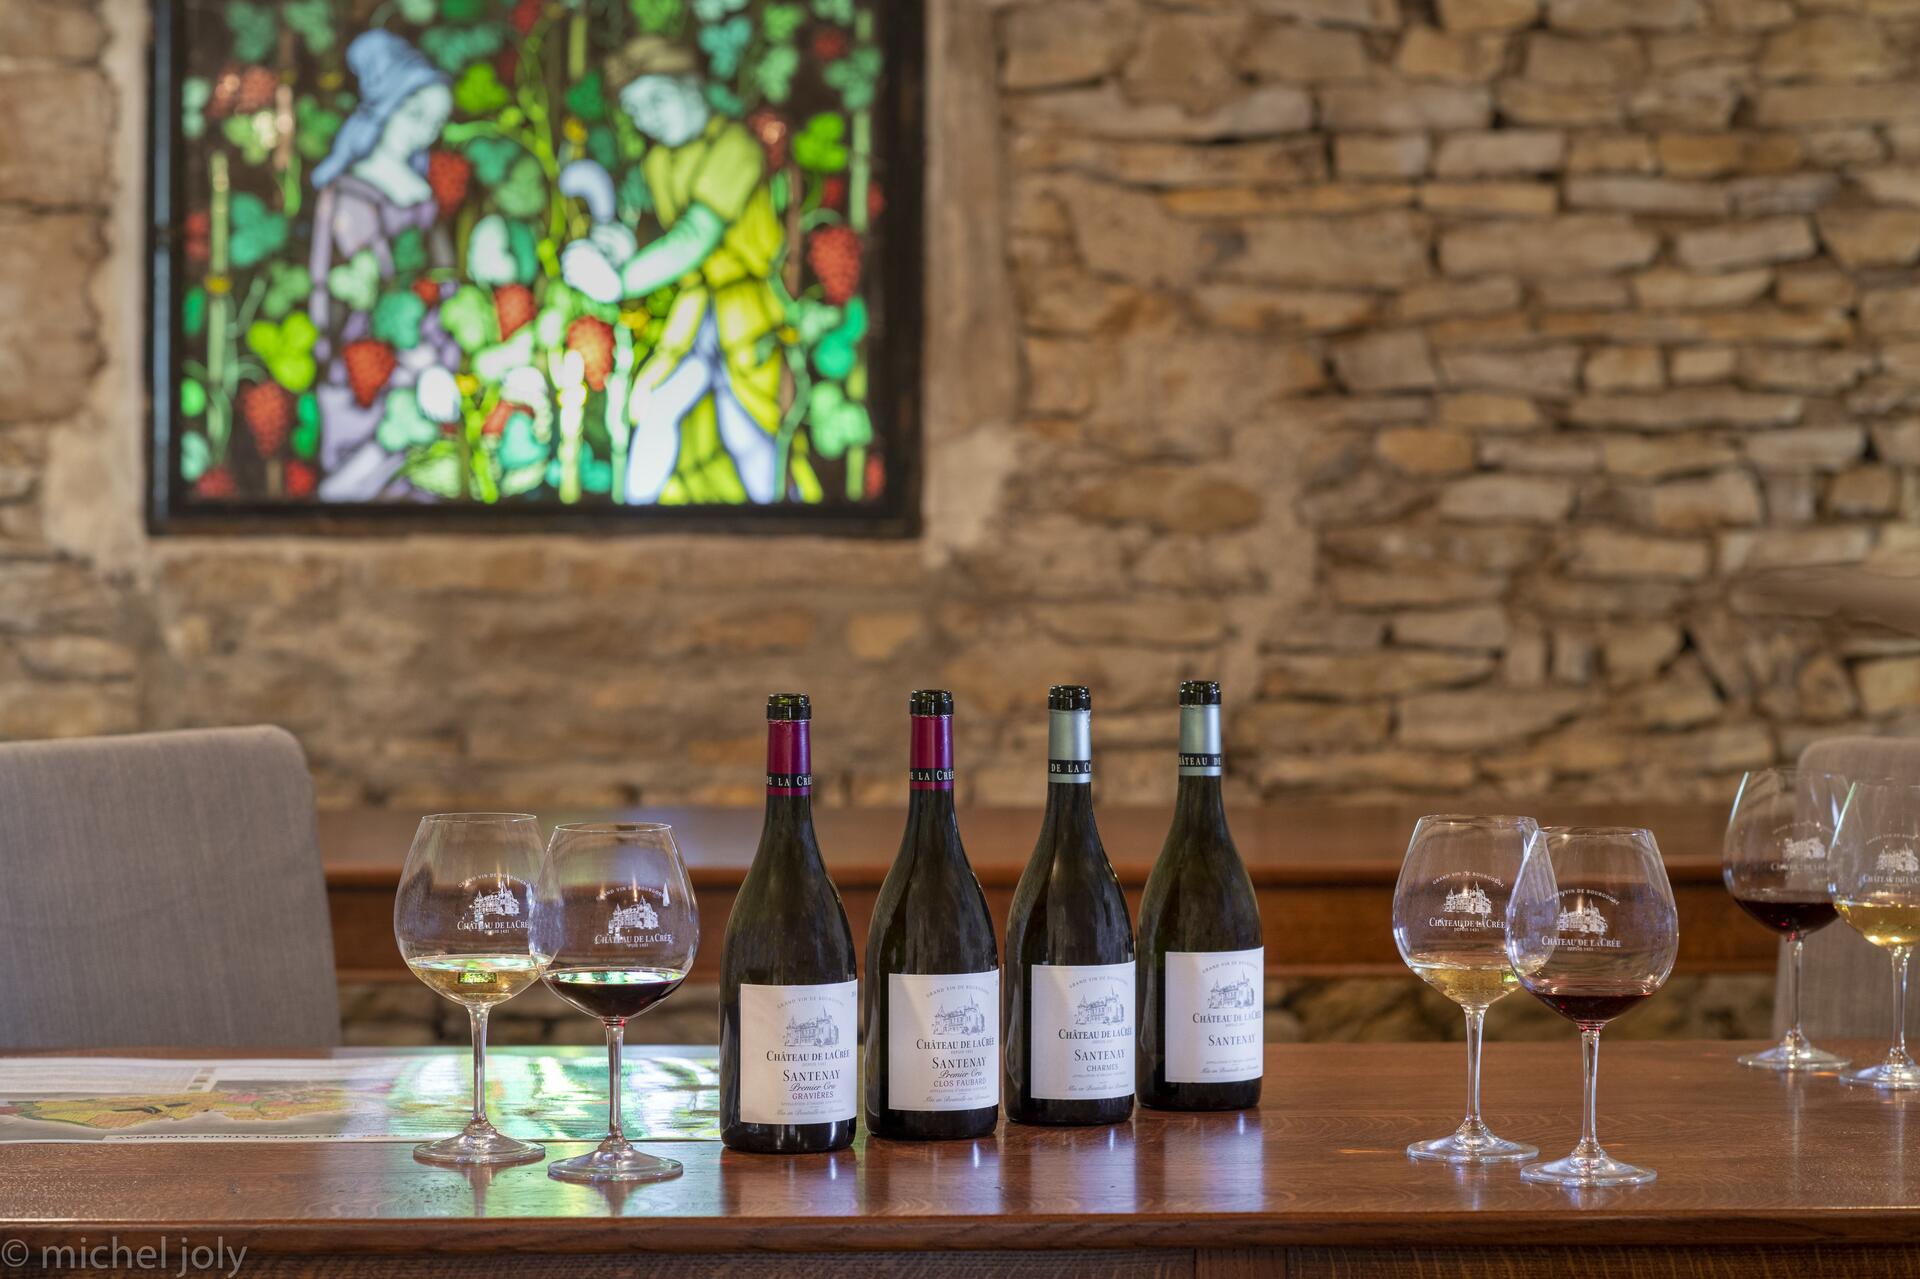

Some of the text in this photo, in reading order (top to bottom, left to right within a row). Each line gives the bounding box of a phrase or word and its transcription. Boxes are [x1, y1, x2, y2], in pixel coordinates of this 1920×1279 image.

[1051, 763, 1061, 772] DE
[1068, 764, 1079, 772] LA
[918, 772, 930, 780] LA
[778, 778, 790, 786] LA
[515, 920, 531, 929] CRÉ
[1193, 1013, 1232, 1023] CHÂTEAU
[1058, 1028, 1099, 1040] CHÂTEAU
[1101, 1030, 1111, 1038] DE
[916, 1039, 958, 1049] CHÂTEAU
[960, 1040, 971, 1048] DE
[1208, 1034, 1255, 1046] SANTENAY
[766, 1050, 810, 1061] CHÂTEAU
[825, 1052, 834, 1060] LA
[1074, 1049, 1124, 1061] SANTENAY
[932, 1056, 986, 1069] SANTENAY
[783, 1069, 840, 1082] SANTENAY
[938, 1070, 968, 1078] Premier
[956, 1078, 986, 1086] FAUBARD
[789, 1083, 821, 1092] Premier
[792, 1091, 834, 1100] GRAVIÈRES
